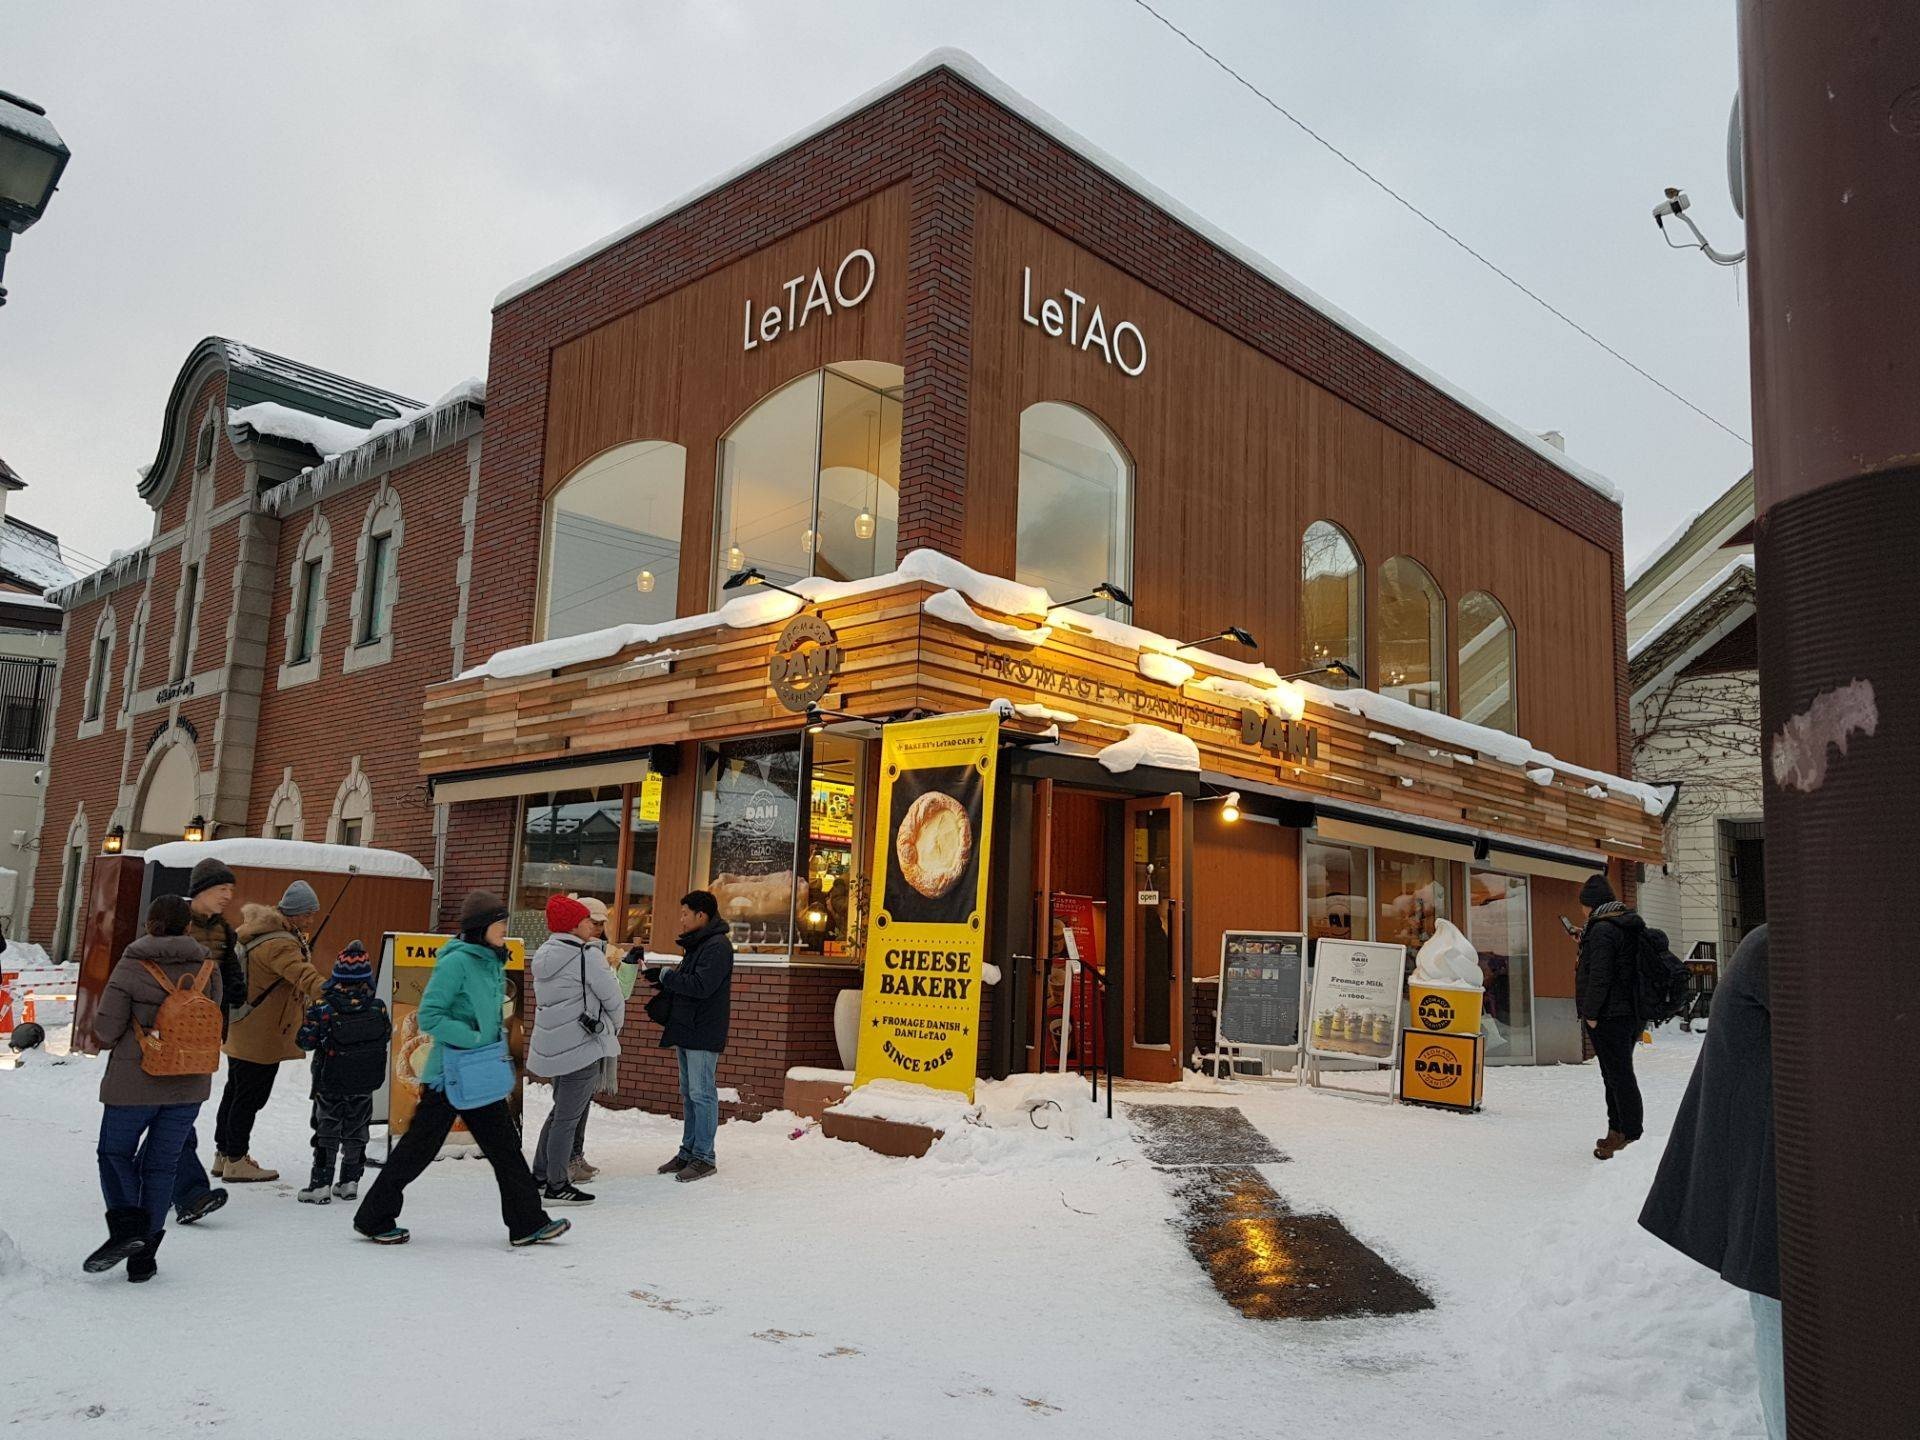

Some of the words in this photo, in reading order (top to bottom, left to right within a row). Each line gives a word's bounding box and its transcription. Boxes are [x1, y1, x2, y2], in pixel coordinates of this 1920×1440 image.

[744, 249, 875, 351] LeTAO
[1024, 266, 1147, 376] LeTAO
[770, 645, 837, 681] DANI
[985, 649, 1105, 699] FROMAGE
[1133, 688, 1216, 727] DANISH
[1240, 708, 1318, 760] DANI
[936, 739, 956, 748] LeTAO
[957, 737, 976, 745] CAFE
[745, 805, 779, 819] DANI
[1140, 894, 1157, 902] open
[405, 946, 438, 958] TAK
[885, 949, 971, 973] CHEESE
[880, 974, 972, 1000] BAKERY
[1330, 976, 1365, 986] Fromage
[1418, 1006, 1455, 1019] DANI
[882, 1016, 925, 1028] FROMAGE
[926, 1020, 960, 1031] DANISH
[894, 1028, 917, 1038] DANI
[918, 1030, 947, 1041] LeTAO
[882, 1040, 921, 1072] SINCE
[923, 1048, 954, 1072] 2018
[1422, 1048, 1454, 1061] FROMAGE
[1415, 1059, 1463, 1076] DANI
[1424, 1076, 1451, 1086] DANISH
